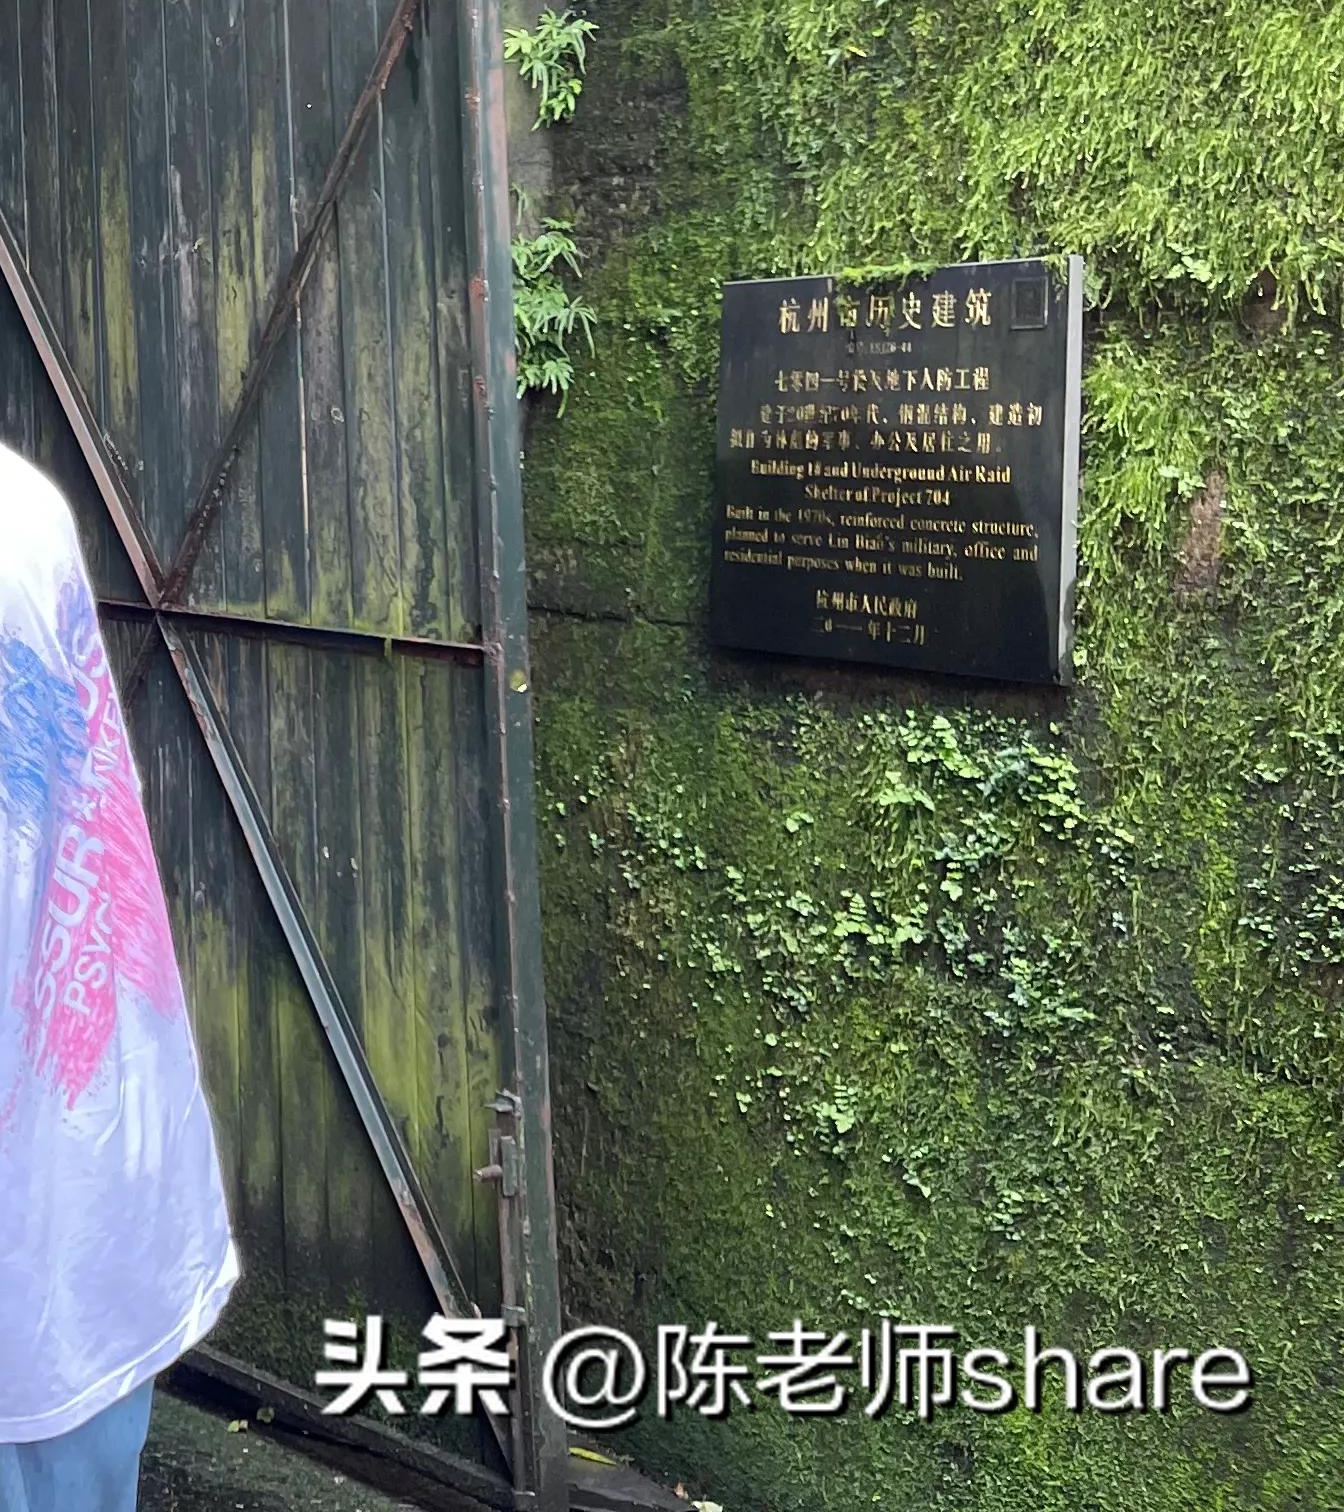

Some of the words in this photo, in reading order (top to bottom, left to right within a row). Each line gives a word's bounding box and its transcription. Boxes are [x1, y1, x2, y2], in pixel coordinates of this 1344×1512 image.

[751, 459, 804, 480] Building
[824, 461, 848, 477] and
[852, 461, 945, 484] Underground
[948, 465, 972, 482] Air
[975, 465, 1012, 483] Raid
[805, 484, 855, 501] Shelter
[855, 486, 869, 502] of
[872, 487, 922, 508] Project
[926, 489, 950, 506] 704
[758, 506, 770, 521] in
[774, 507, 791, 522] the
[840, 511, 905, 529] reinforced
[910, 517, 966, 533] concrete
[972, 519, 1039, 538] structure,
[725, 526, 768, 543] planned
[774, 529, 785, 544] to
[792, 534, 822, 547] serve
[829, 533, 849, 549] Lin
[964, 541, 1006, 560] office
[1013, 545, 1038, 561] and
[724, 548, 783, 566] residential
[787, 555, 840, 571] purposes
[845, 556, 877, 574] when
[882, 560, 892, 575] it
[898, 563, 922, 577] was
